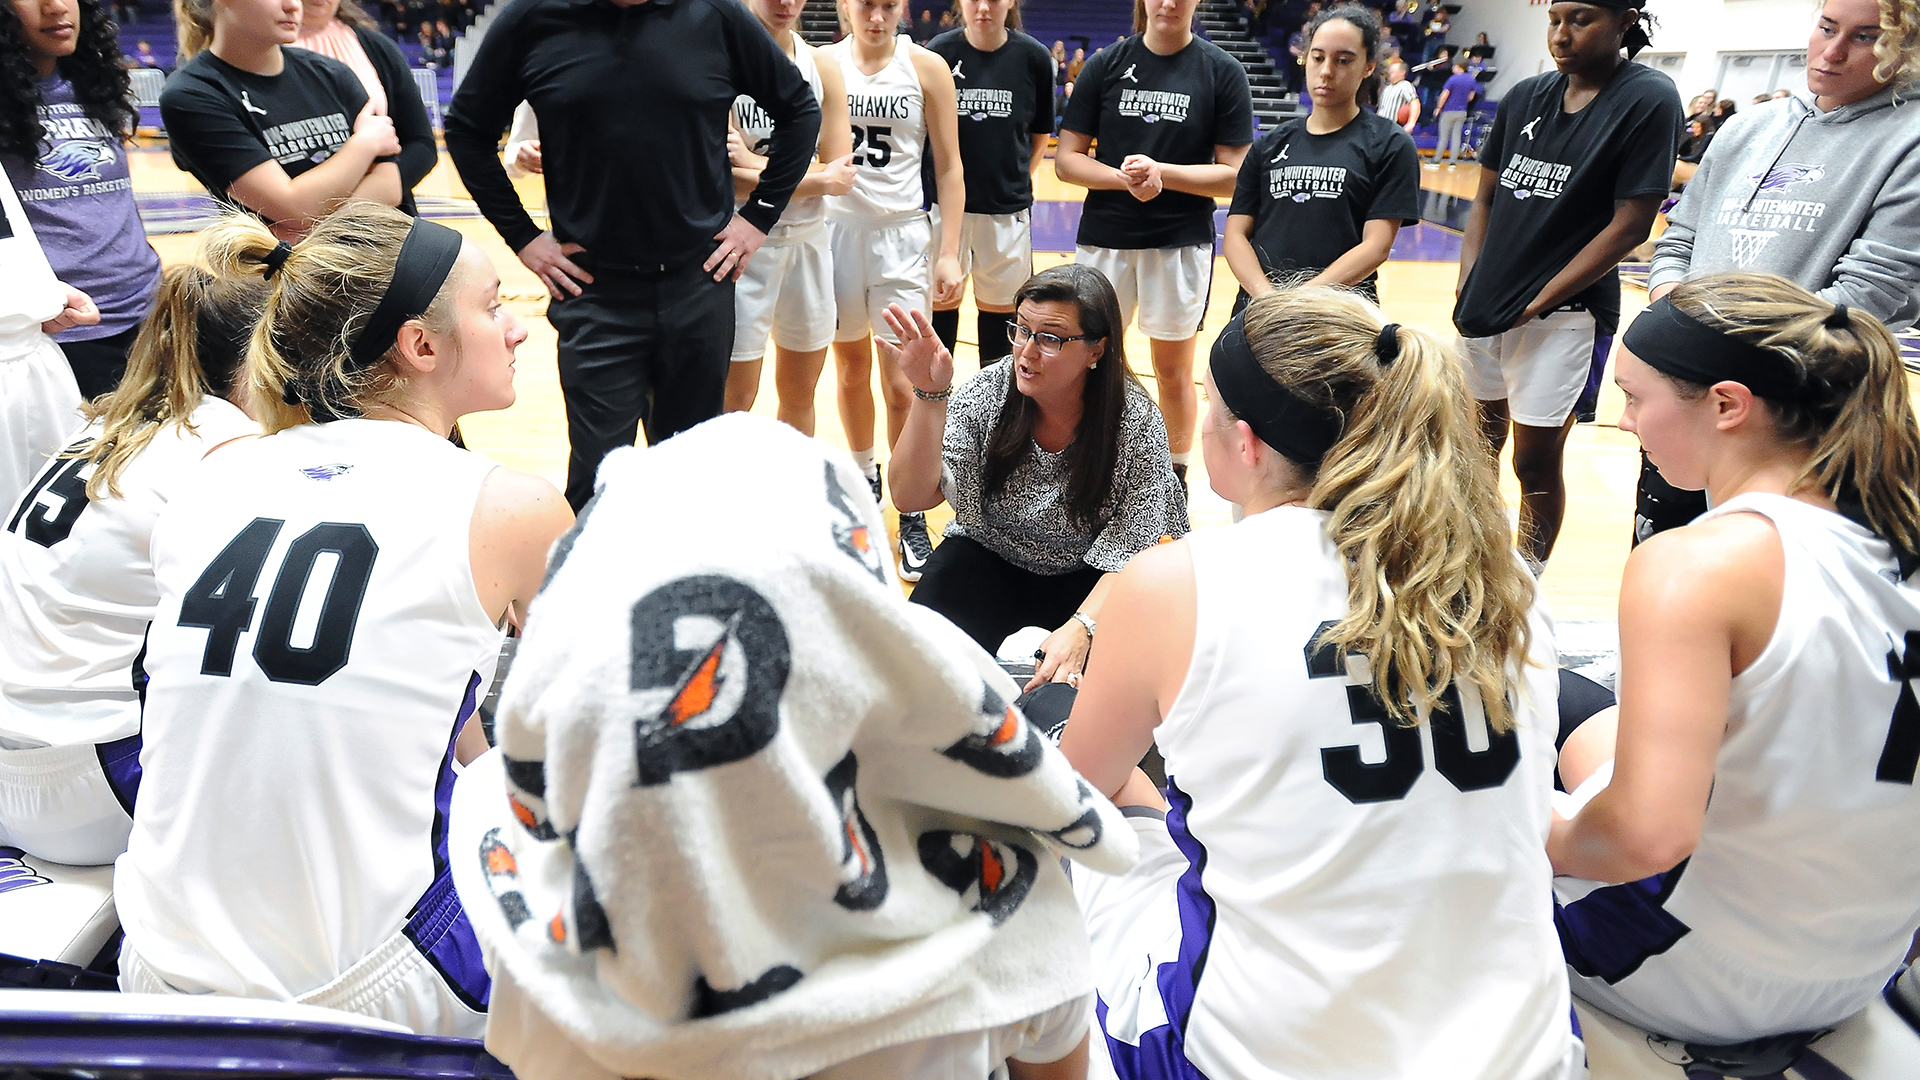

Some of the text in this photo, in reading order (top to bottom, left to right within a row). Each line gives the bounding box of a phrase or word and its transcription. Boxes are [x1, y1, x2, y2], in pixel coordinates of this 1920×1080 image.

[847, 95, 909, 119] RHAWKS
[956, 101, 1012, 112] ASKETBALL
[1121, 88, 1190, 109] UW-WHITEWATER
[1118, 101, 1187, 118] BASKETBALL
[851, 124, 892, 168] 25
[1269, 165, 1347, 183] UW-WHITEWATER
[18, 184, 80, 201] WOMEN'S
[1269, 180, 1344, 193] BASKETBALL
[7, 436, 112, 549] 15
[176, 516, 380, 687] 40
[1303, 619, 1523, 805] 30
